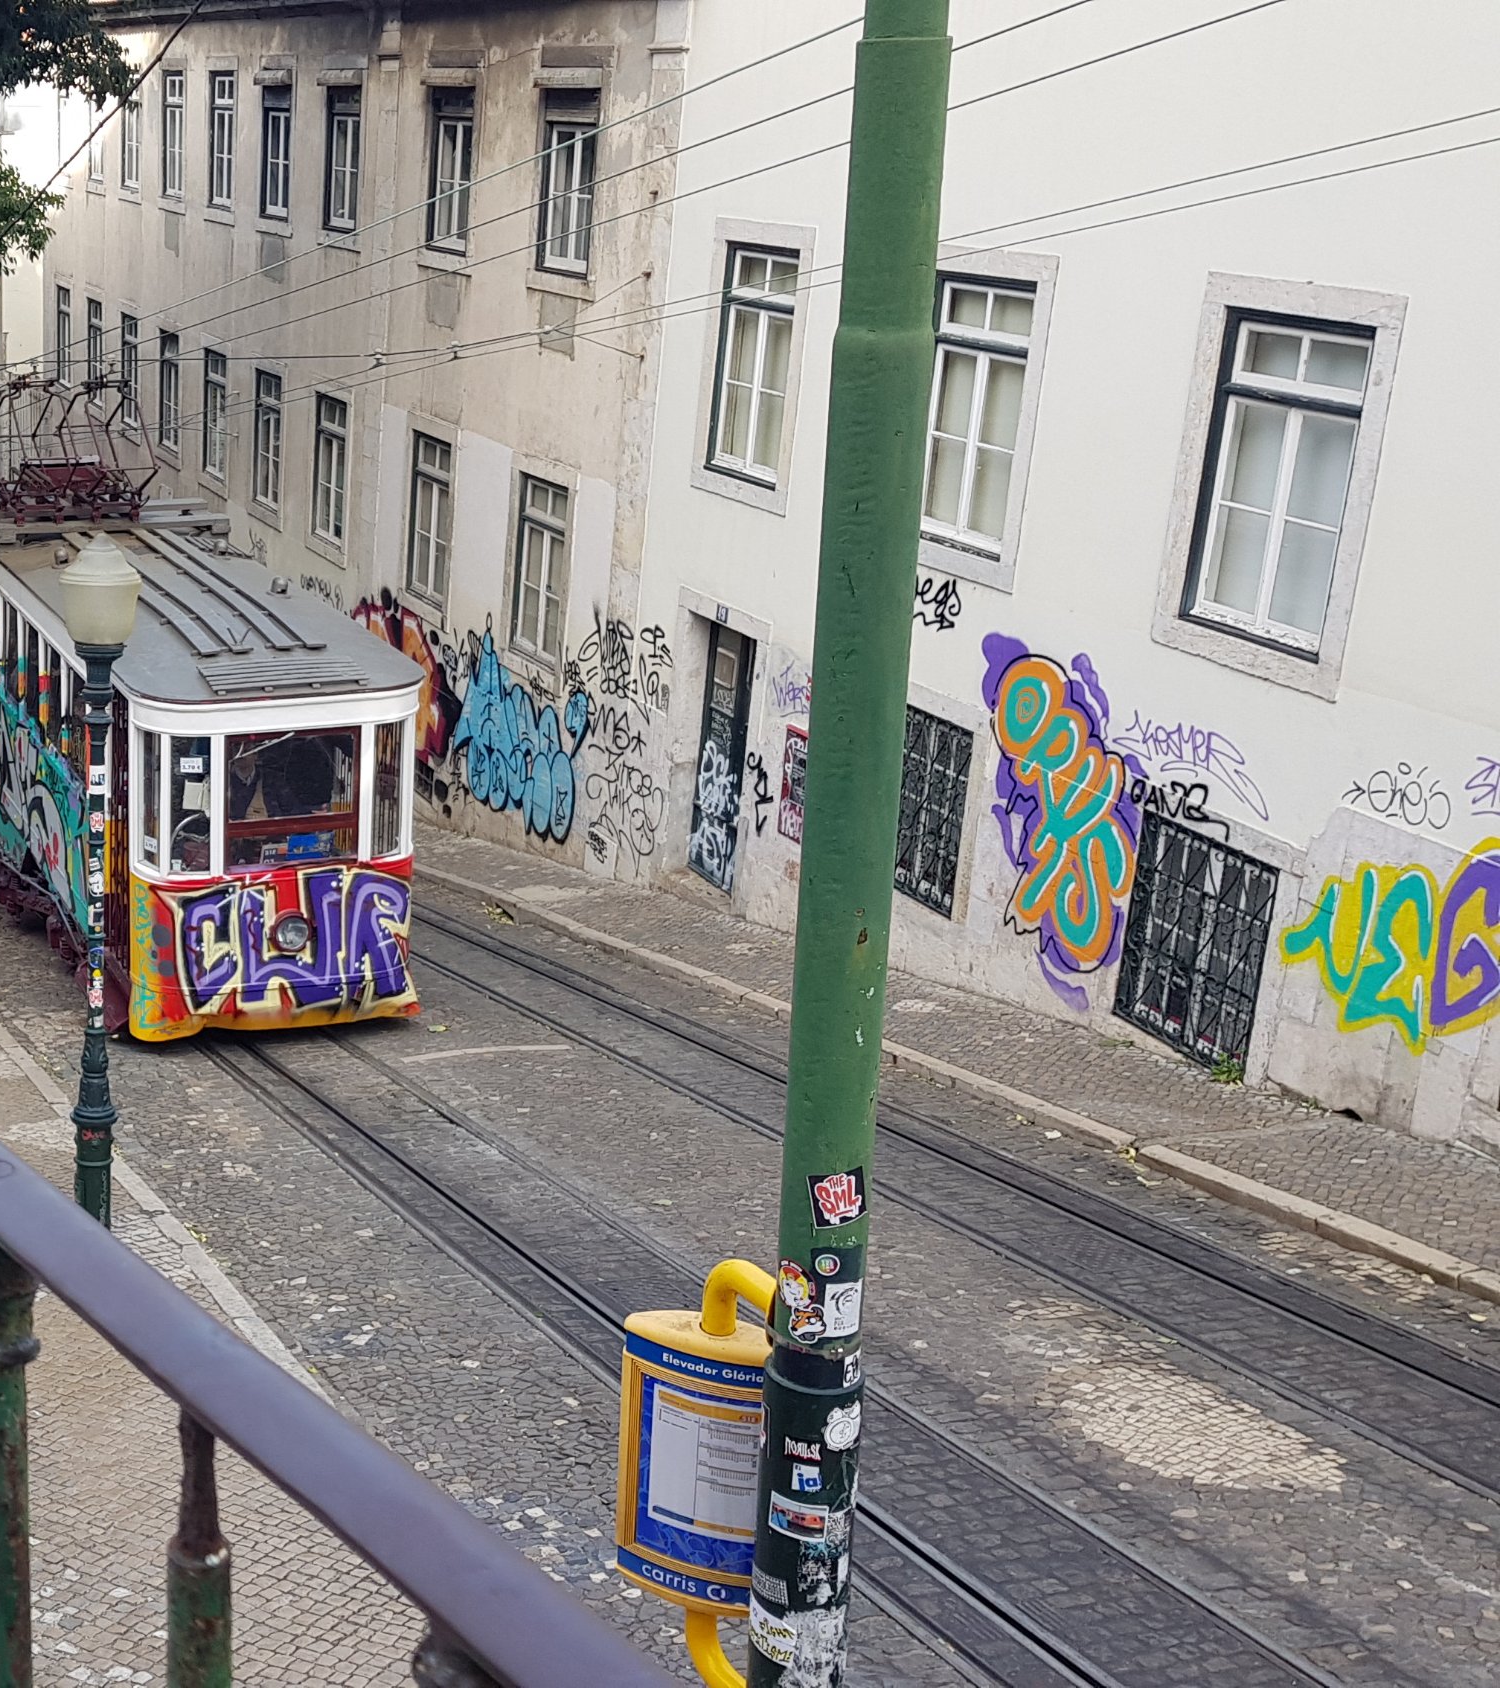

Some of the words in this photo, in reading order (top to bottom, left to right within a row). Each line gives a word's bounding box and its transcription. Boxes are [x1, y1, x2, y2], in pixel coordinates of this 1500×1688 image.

[816, 1178, 861, 1214] SML
[826, 1174, 846, 1189] THE
[662, 1352, 718, 1376] Elevador
[722, 1368, 764, 1383] Glória
[642, 1564, 697, 1593] carris
